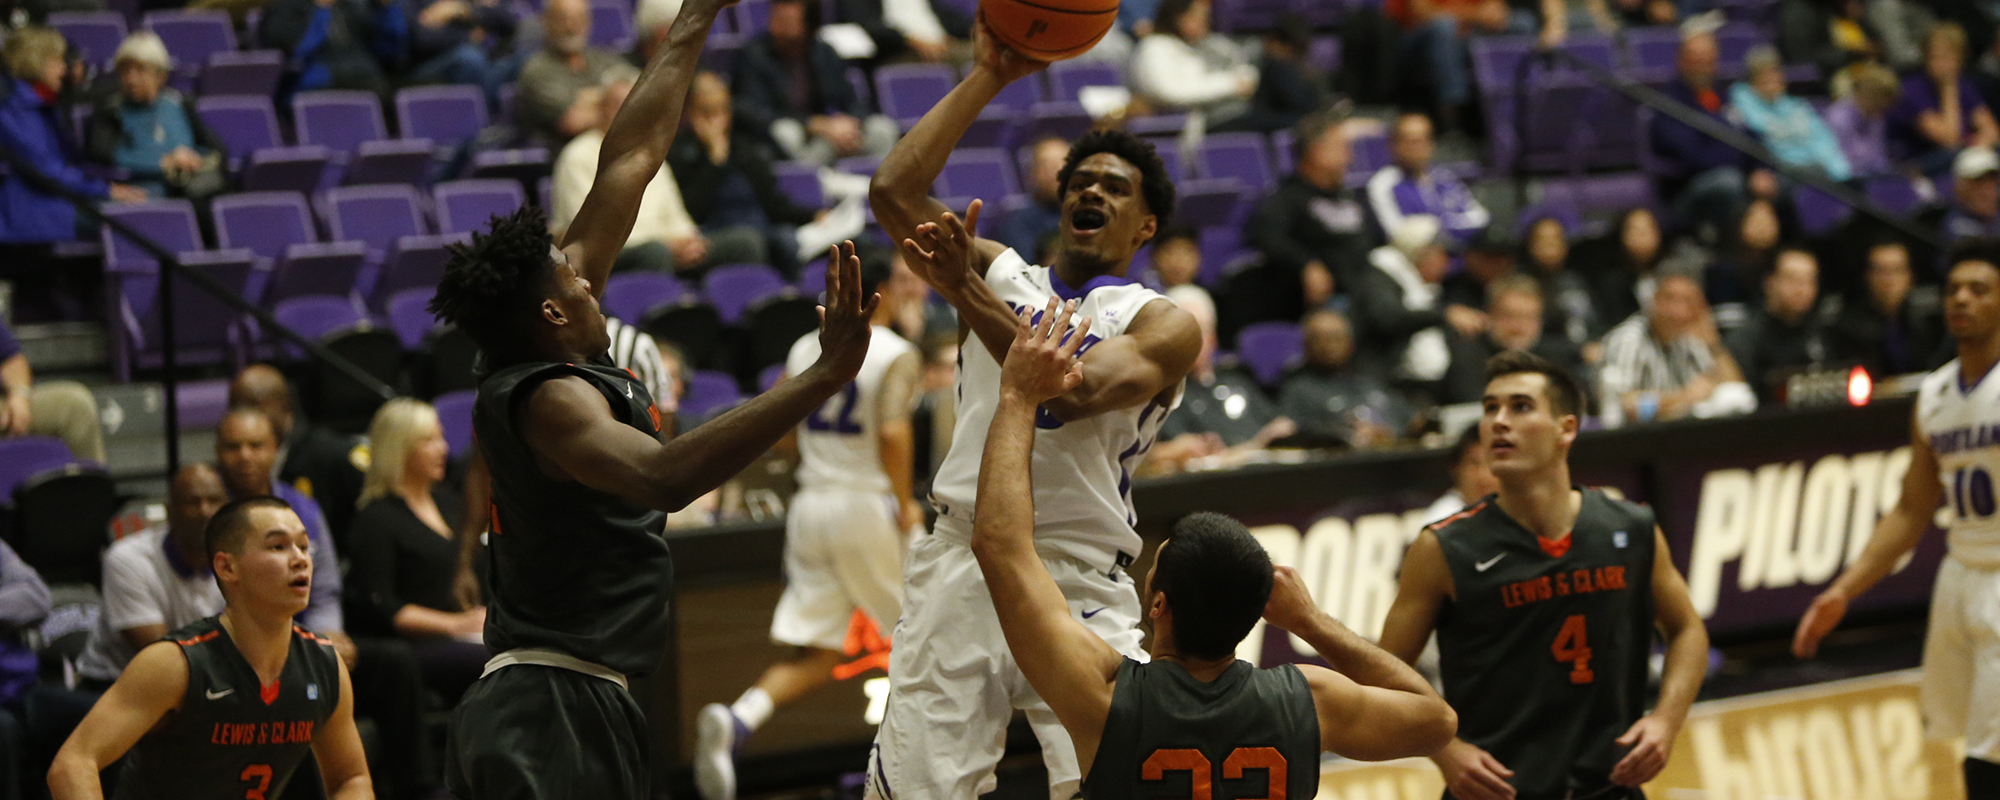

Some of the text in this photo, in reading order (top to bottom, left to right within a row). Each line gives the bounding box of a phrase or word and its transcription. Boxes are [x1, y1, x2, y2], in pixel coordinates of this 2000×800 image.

[1955, 466, 1997, 517] 10
[1501, 565, 1627, 608] LEWIS & CLARK
[1551, 614, 1594, 684] 4
[211, 721, 314, 745] LEWIS & CLARK
[241, 764, 273, 800] 3
